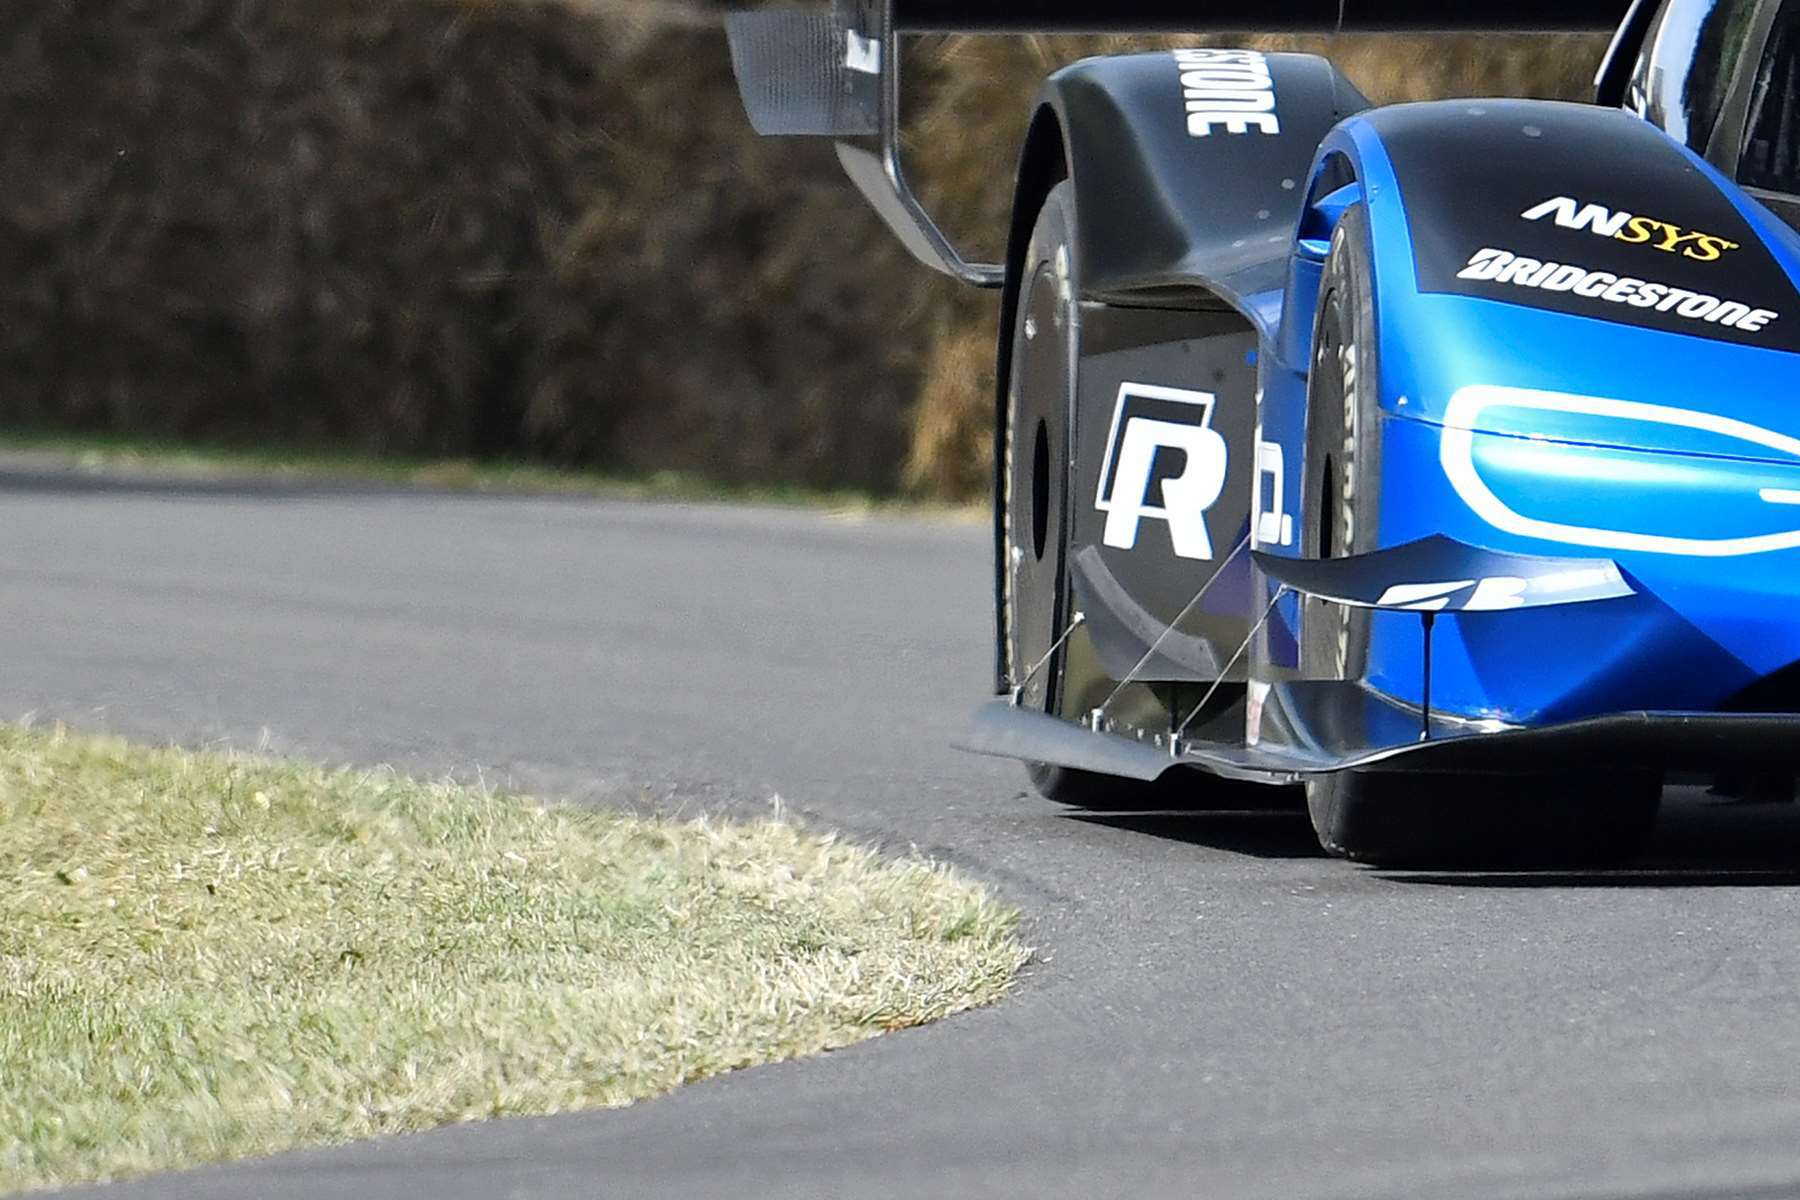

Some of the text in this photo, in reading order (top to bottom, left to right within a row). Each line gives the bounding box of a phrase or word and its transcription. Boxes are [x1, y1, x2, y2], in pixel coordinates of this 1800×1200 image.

[1173, 49, 1280, 138] STONE
[1521, 196, 1733, 262] ANSYS
[1456, 248, 1779, 332] BRIDGESTONE
[1096, 388, 1228, 560] R
